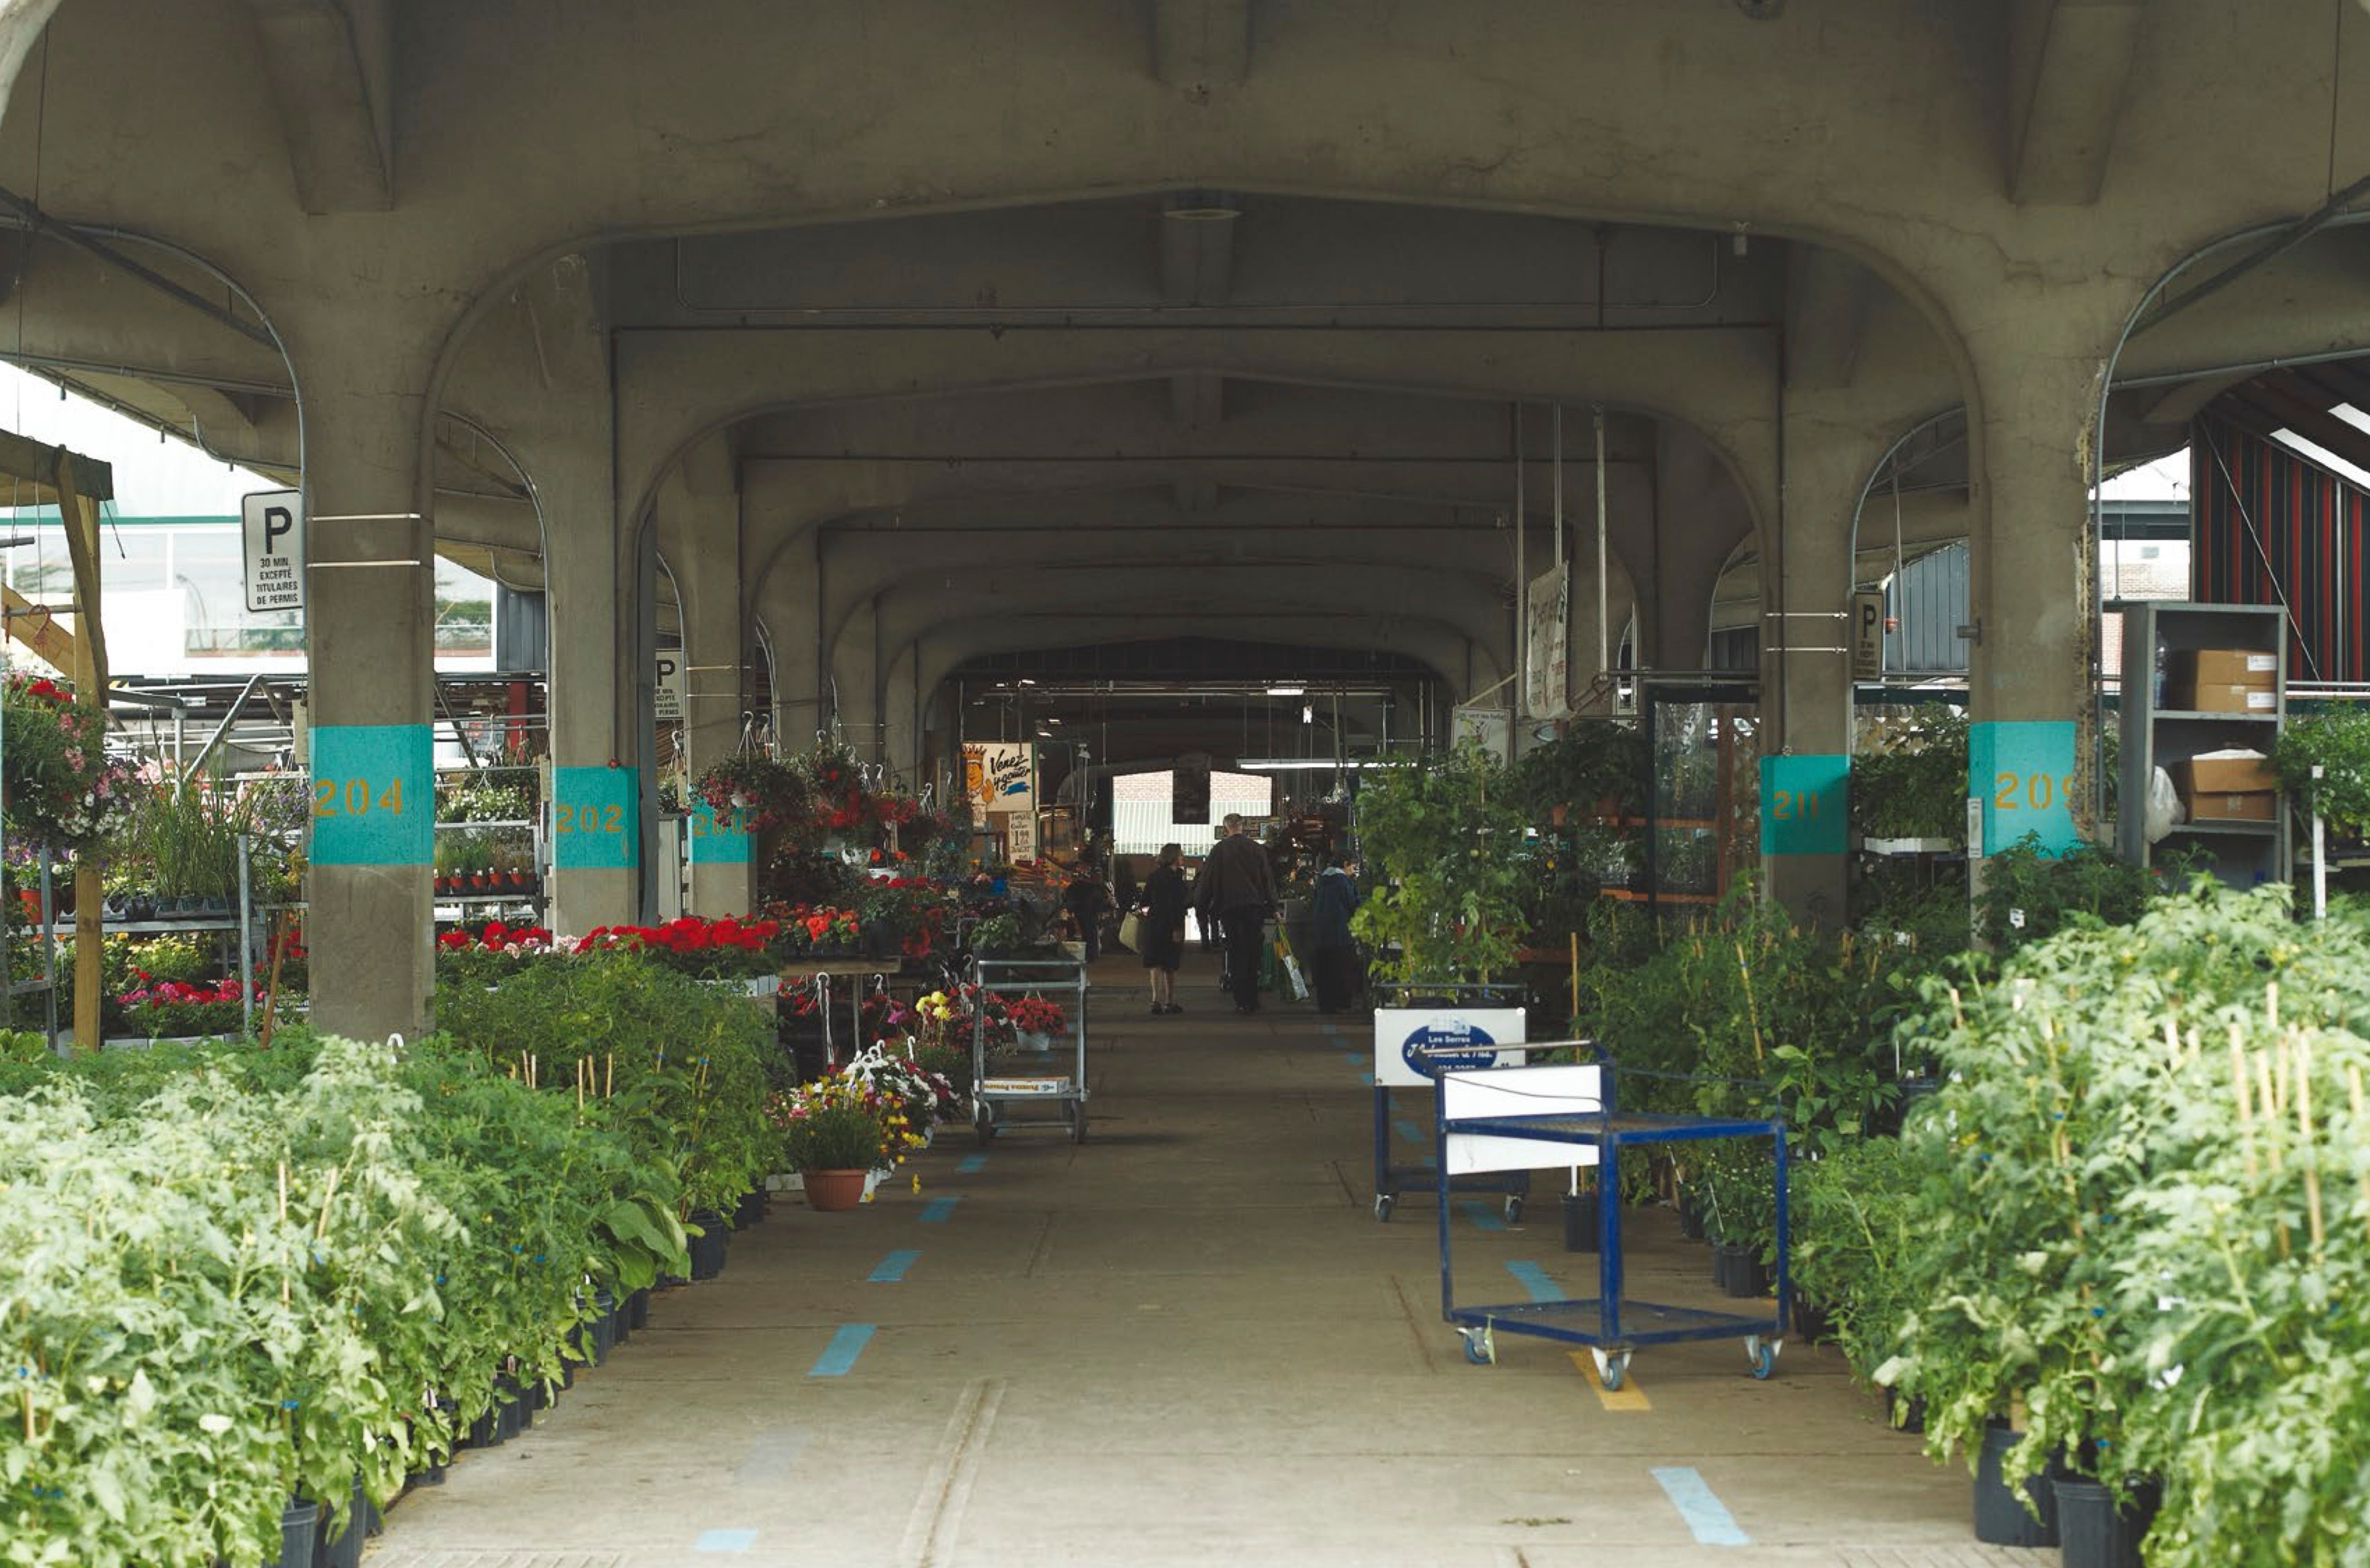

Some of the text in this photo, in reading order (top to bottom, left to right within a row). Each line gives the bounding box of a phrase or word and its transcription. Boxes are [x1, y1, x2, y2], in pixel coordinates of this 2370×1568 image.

[265, 506, 292, 554] P
[259, 558, 271, 568] 30
[259, 566, 292, 580] EXCEPTÉ
[256, 580, 298, 592] TITULAIRES
[257, 593, 298, 605] DE PERMIS
[1863, 604, 1877, 639] P
[657, 660, 676, 687] P
[990, 748, 1029, 775] Venez
[313, 777, 402, 817] 204
[1772, 789, 1819, 821] 211
[555, 804, 623, 832] 202
